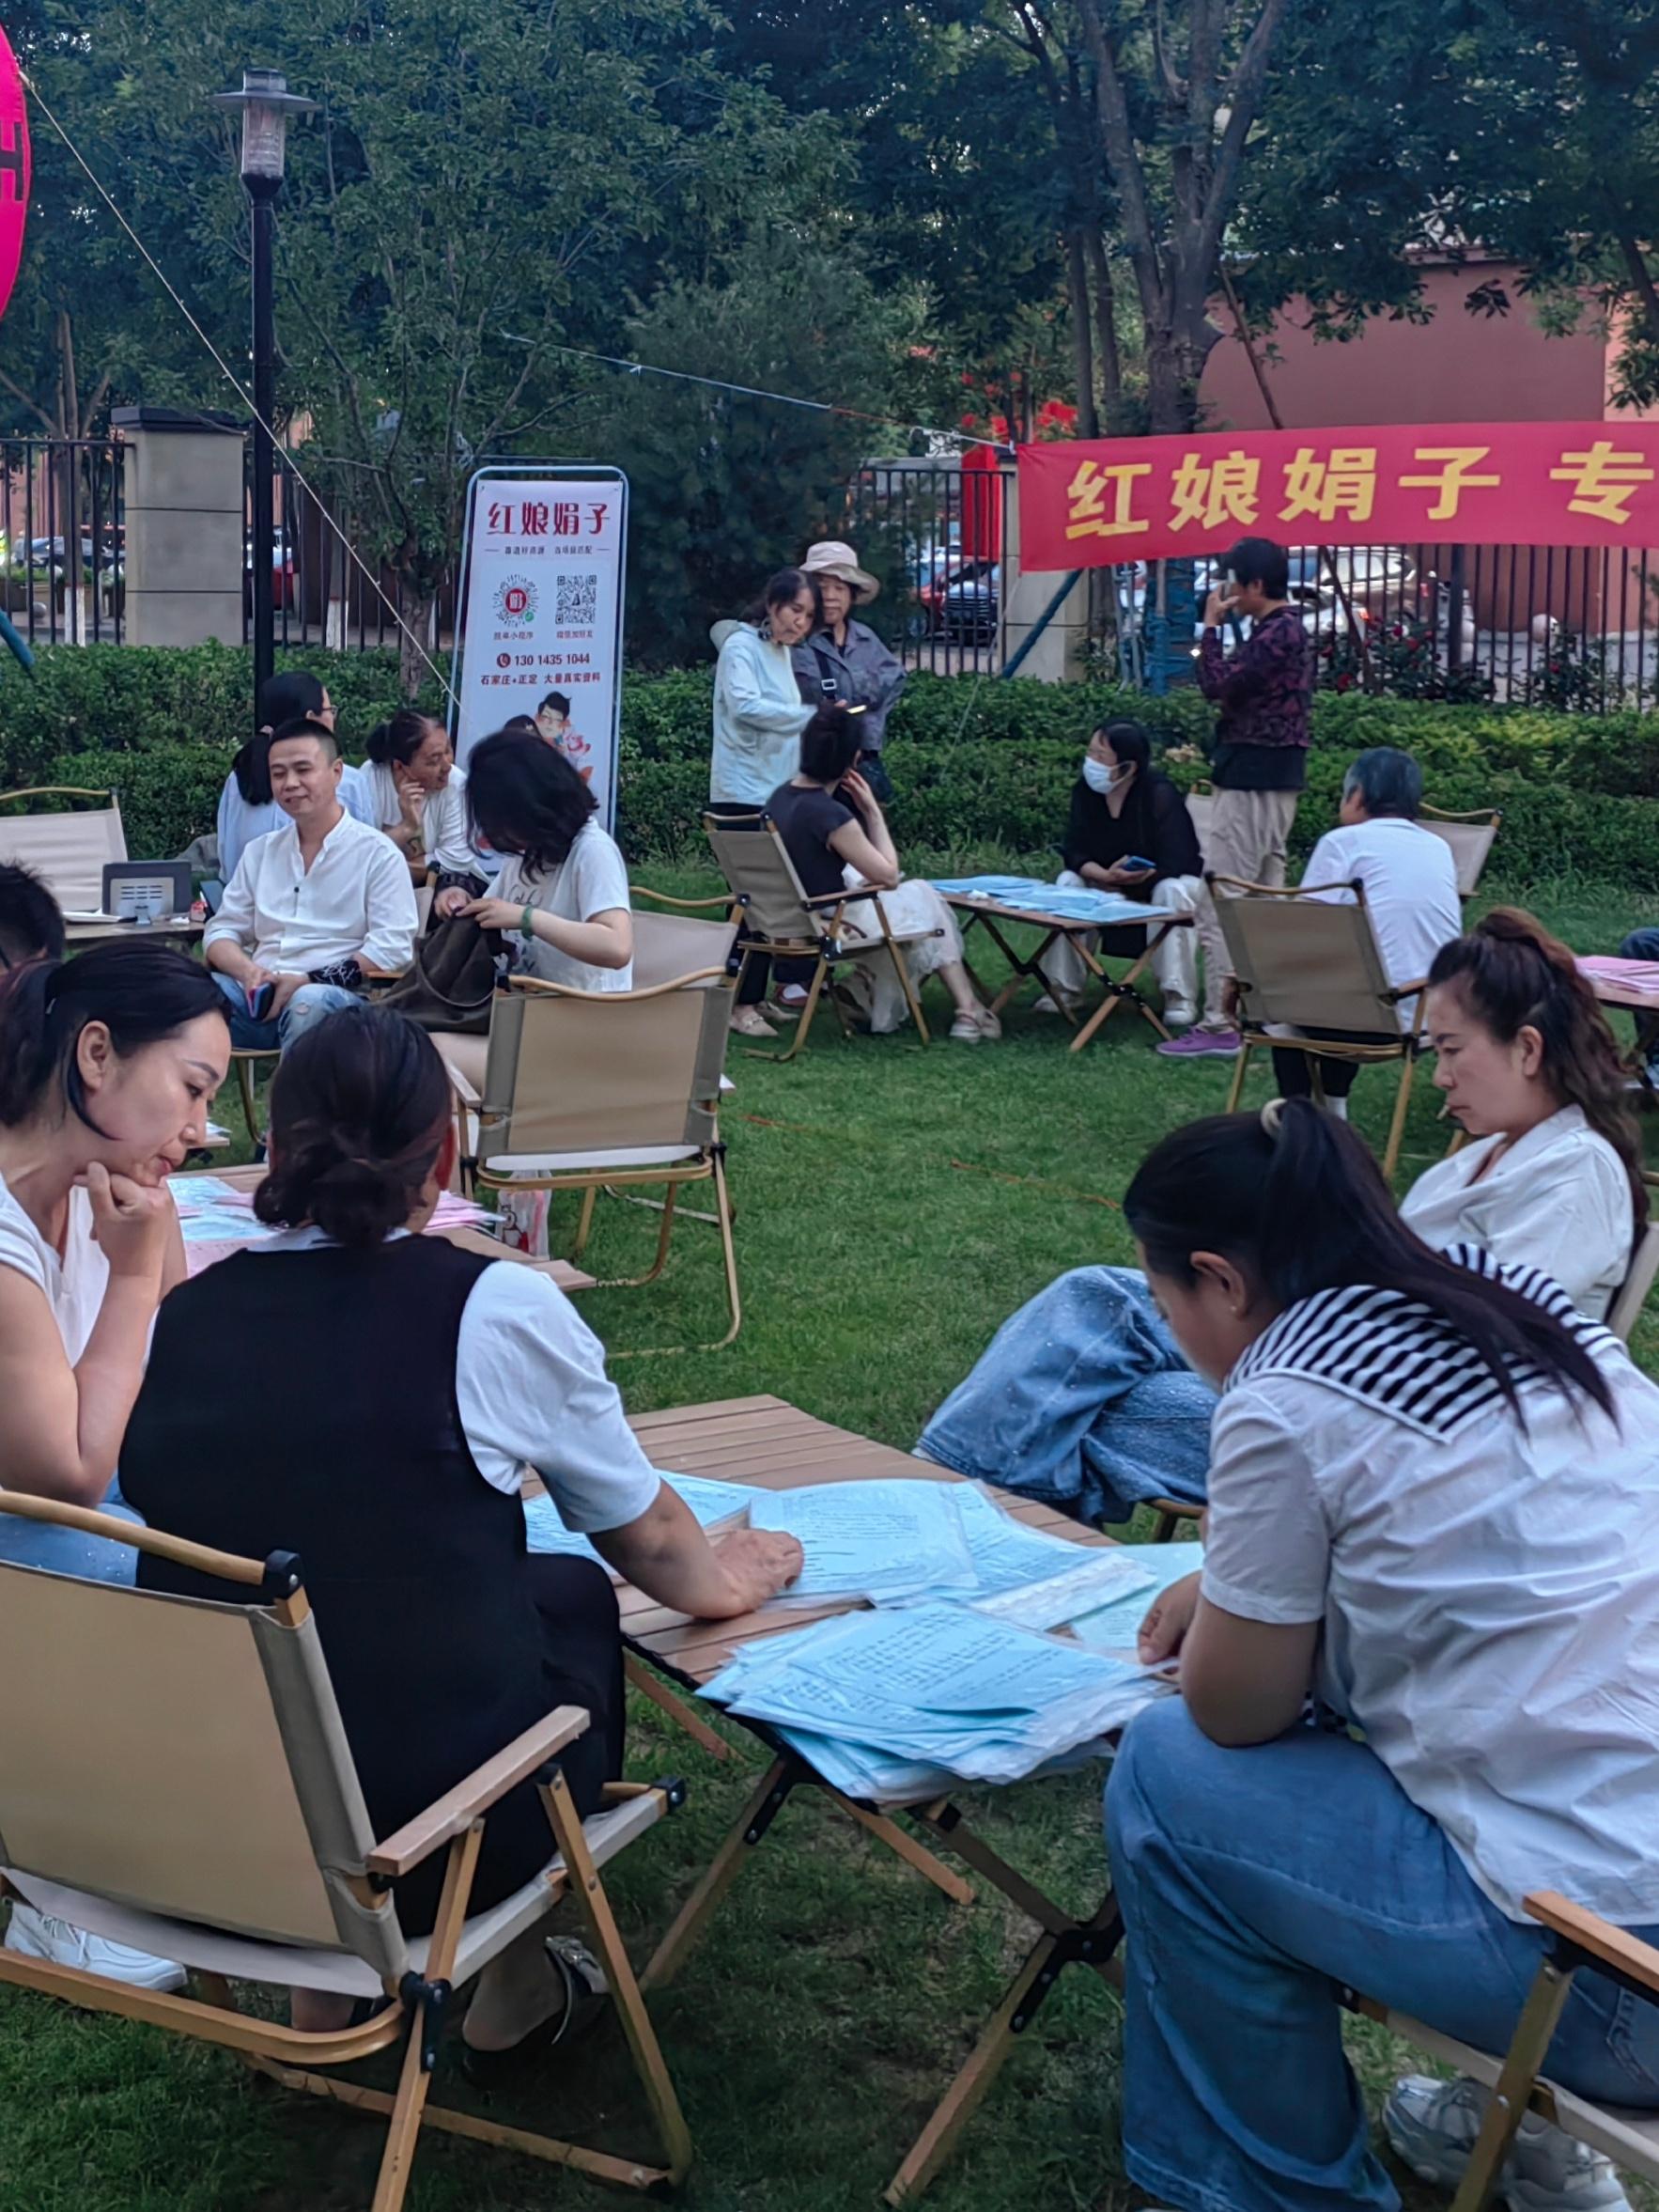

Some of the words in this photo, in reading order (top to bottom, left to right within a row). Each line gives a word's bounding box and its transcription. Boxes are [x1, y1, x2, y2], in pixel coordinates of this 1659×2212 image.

[1065, 444, 1500, 541] 红娘娟子
[1549, 442, 1654, 524] 专
[487, 502, 610, 536] 红娘娟子
[515, 655, 534, 665] 130
[538, 654, 563, 665] 1435
[566, 653, 590, 664] 1044
